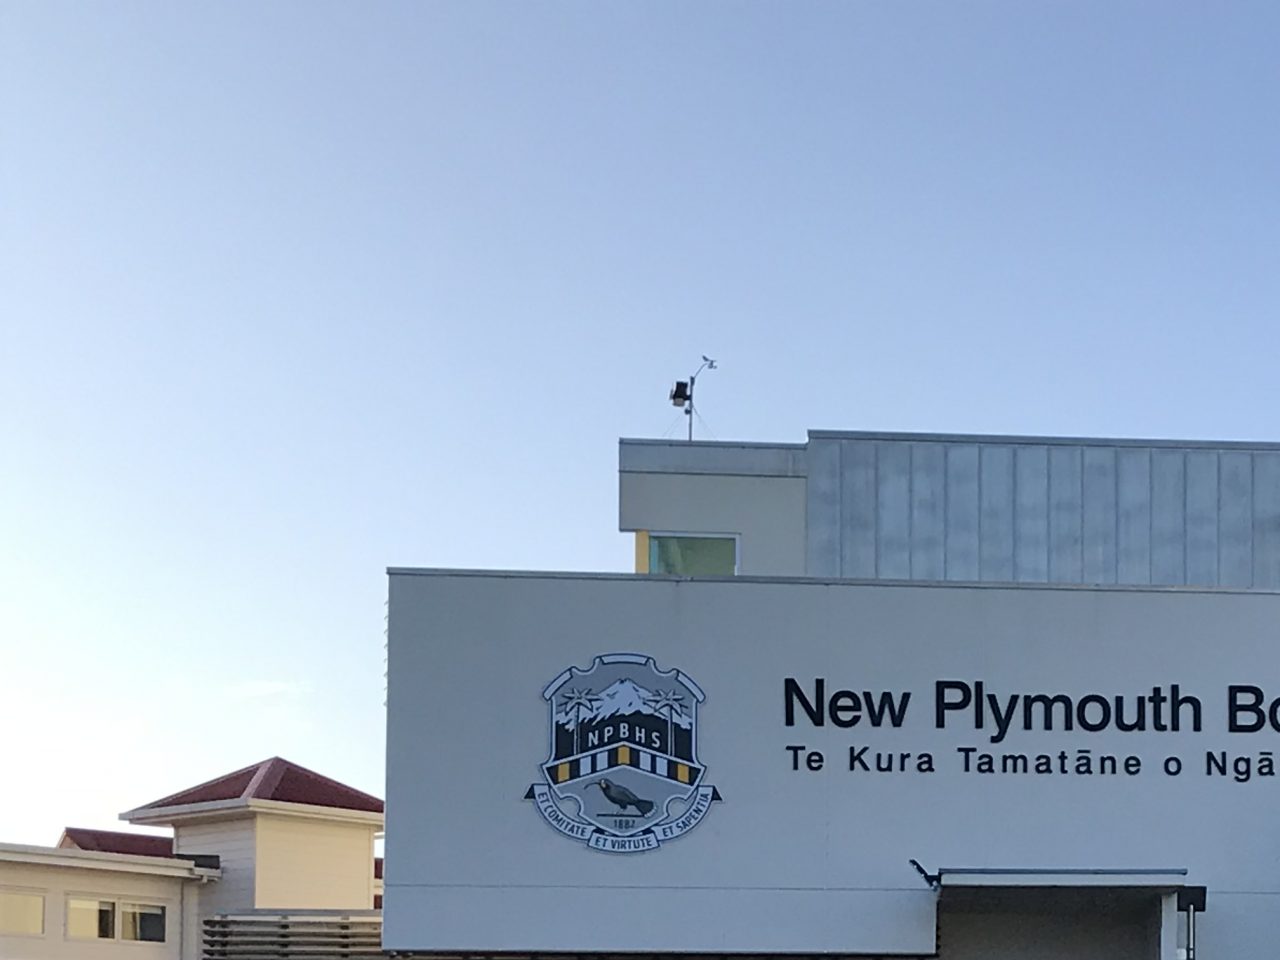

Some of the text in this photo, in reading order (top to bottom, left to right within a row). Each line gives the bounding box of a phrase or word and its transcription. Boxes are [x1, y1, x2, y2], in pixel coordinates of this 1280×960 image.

[784, 678, 911, 728] New
[935, 680, 1202, 743] Plymouth
[588, 722, 661, 748] NPBHS
[786, 746, 825, 772] Te
[849, 747, 935, 773] Kura
[957, 748, 1142, 776] Tamatāne
[1163, 755, 1182, 777] o
[538, 792, 587, 836] ET COMITATE
[595, 836, 652, 850] ET VIRTUTE
[662, 826, 674, 837] ET
